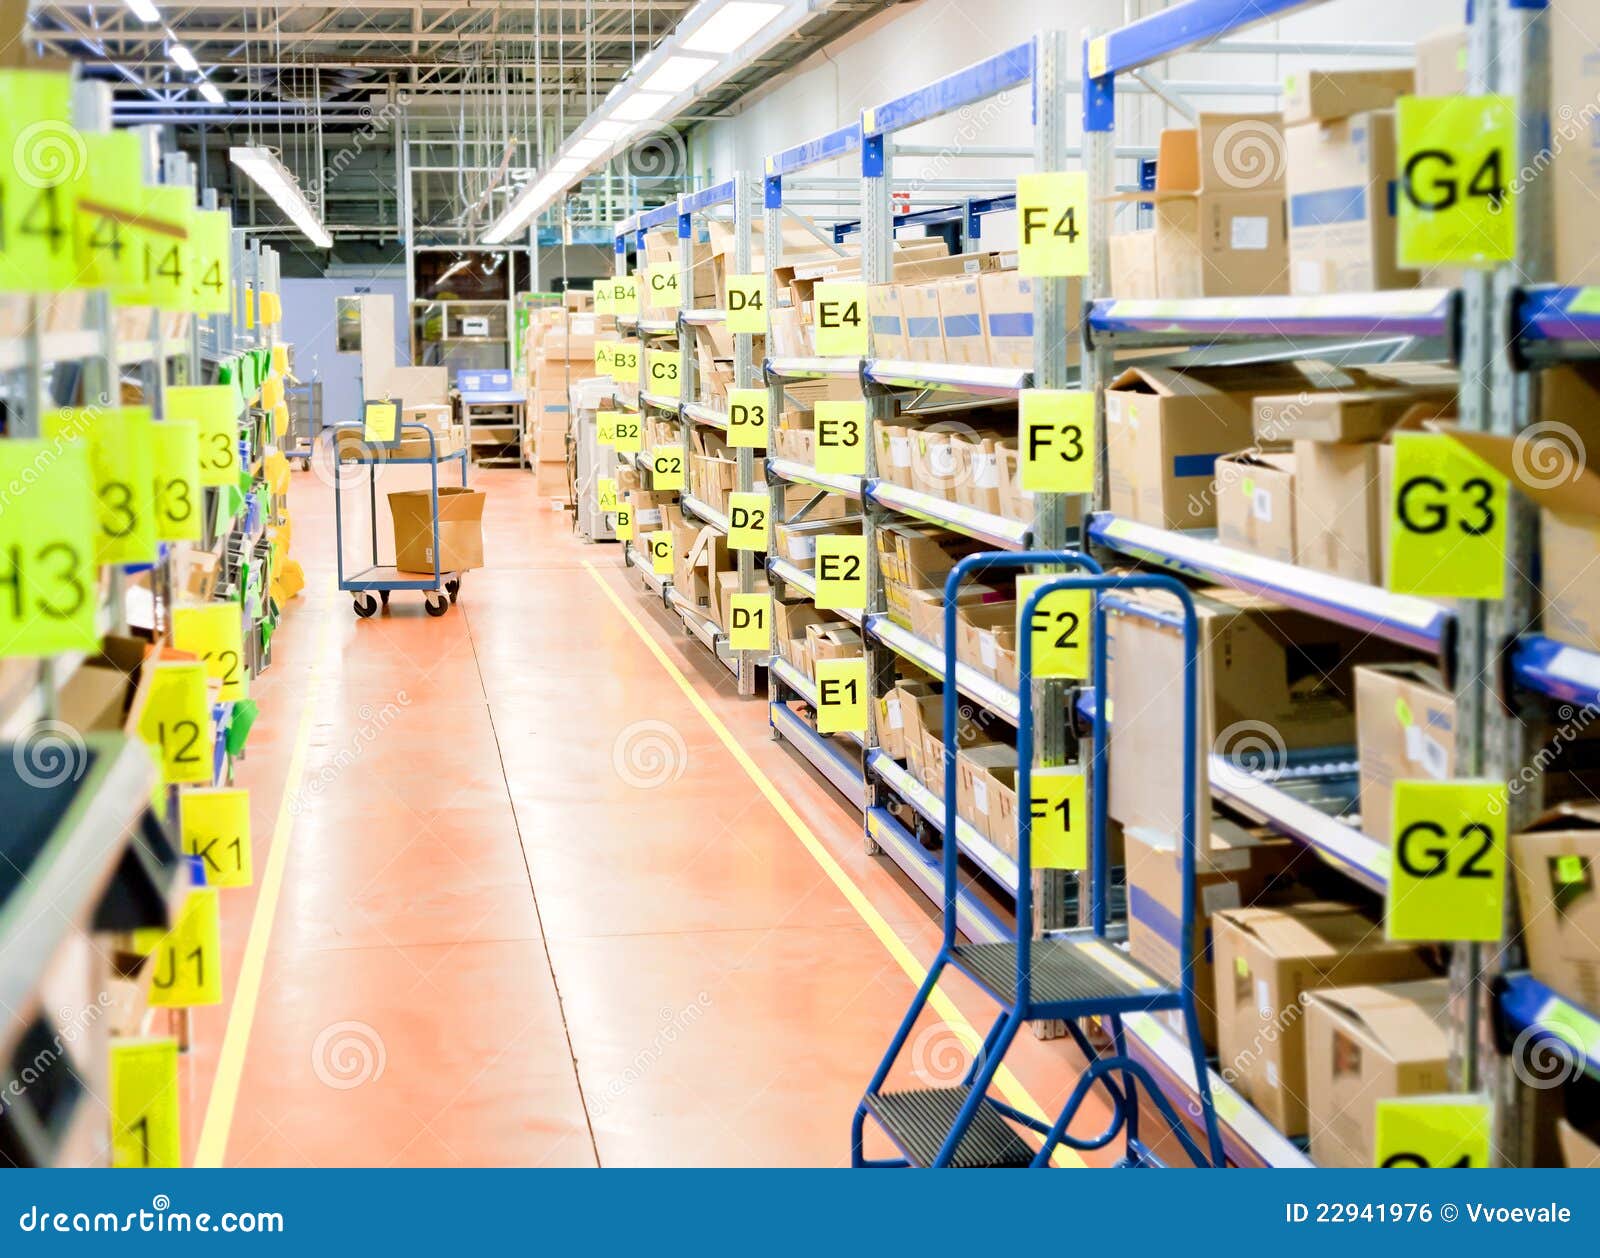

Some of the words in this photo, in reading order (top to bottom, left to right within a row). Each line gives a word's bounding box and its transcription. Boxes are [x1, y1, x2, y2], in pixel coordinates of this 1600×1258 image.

[1403, 147, 1508, 212] G4
[0, 181, 66, 253] 4
[1024, 206, 1080, 245] F4
[192, 258, 223, 294] 4
[651, 274, 678, 291] C4
[597, 289, 612, 300] A
[614, 286, 636, 300] B4
[728, 290, 763, 311] D4
[819, 302, 861, 328] E4
[597, 350, 613, 361] A
[615, 353, 637, 368] B3
[652, 362, 678, 380] C3
[730, 404, 765, 427] D3
[616, 424, 638, 438] B2
[819, 420, 860, 447] E3
[1028, 424, 1084, 462] F3
[198, 433, 233, 469] 3
[655, 457, 681, 474] C2
[731, 507, 765, 530] D2
[1396, 475, 1496, 536] G3
[655, 541, 673, 558] C
[819, 554, 861, 581] E2
[732, 608, 763, 629] D1
[202, 650, 239, 686] 2
[820, 679, 858, 706] E1
[192, 837, 242, 873] K1
[1396, 820, 1495, 880] G2
[152, 944, 204, 989] J1
